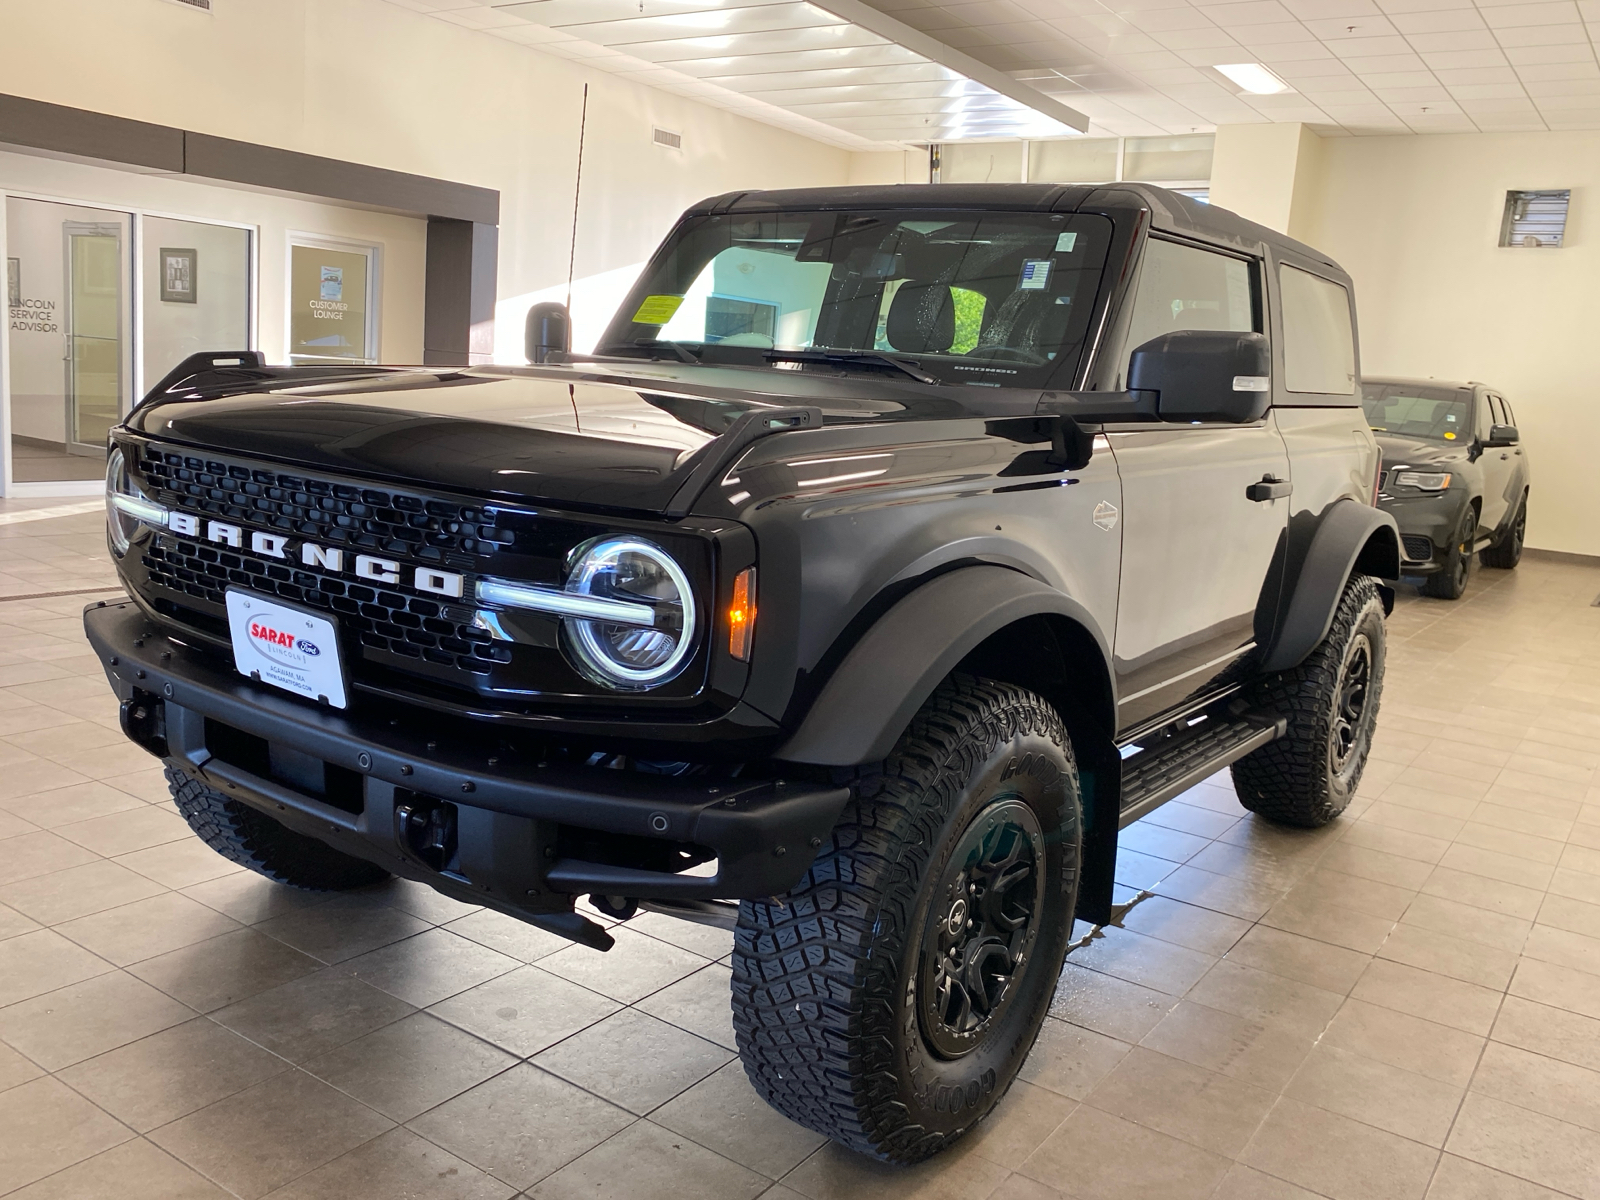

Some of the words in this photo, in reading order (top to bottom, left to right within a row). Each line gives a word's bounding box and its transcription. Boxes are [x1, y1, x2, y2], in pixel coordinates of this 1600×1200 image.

[9, 297, 55, 310] LINCOLN
[309, 299, 348, 311] CUSTOMER
[10, 308, 52, 321] SERVICE
[313, 309, 344, 320] LOUNGE
[11, 321, 58, 333] ADVISOR
[168, 510, 466, 599] BRONCO
[251, 623, 295, 649] SARAT
[298, 641, 319, 657] Ford
[272, 646, 302, 661] LINCOLN
